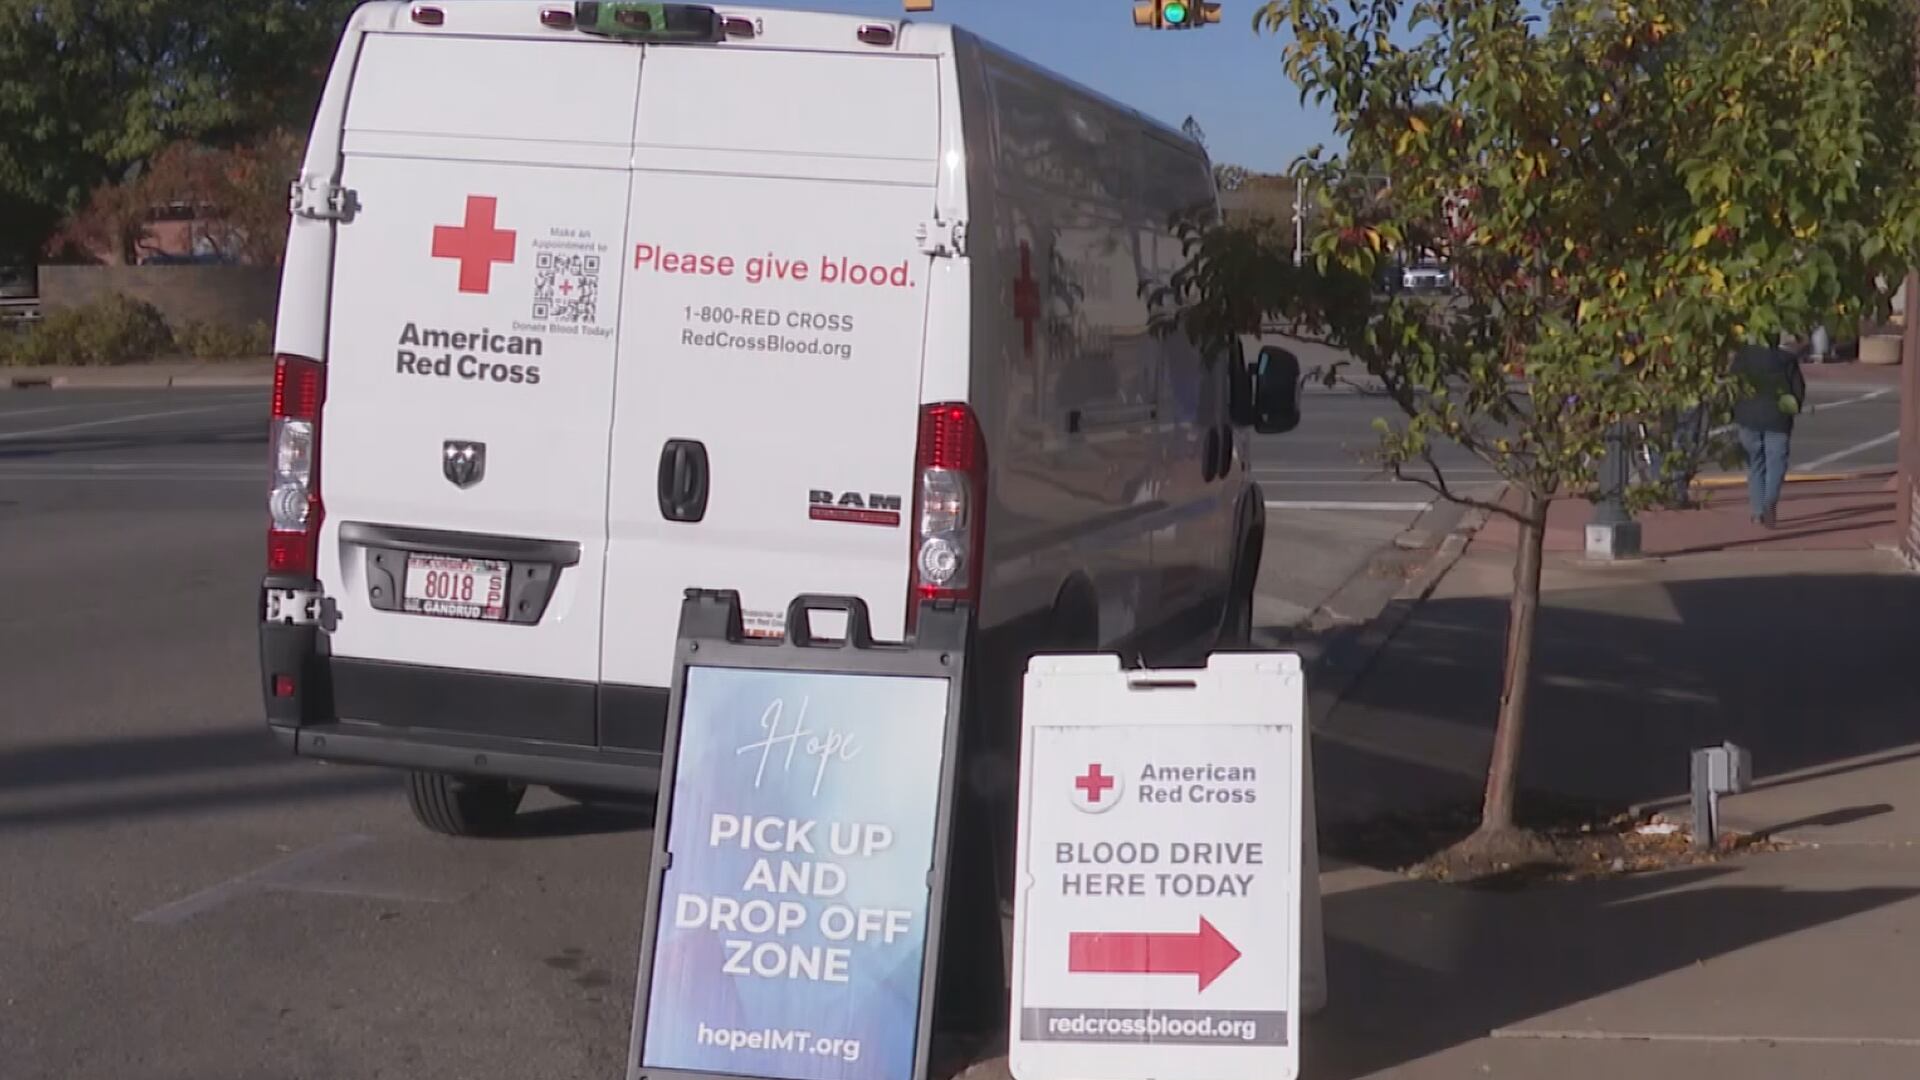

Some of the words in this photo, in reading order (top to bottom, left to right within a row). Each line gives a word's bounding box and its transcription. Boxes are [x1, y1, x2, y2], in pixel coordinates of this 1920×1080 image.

[532, 239, 595, 250] Appointment
[550, 227, 576, 237] Make
[633, 244, 735, 275] Please
[745, 252, 809, 284] give
[820, 255, 916, 287] blood.
[512, 321, 546, 332] Donate
[549, 323, 579, 334] Blood
[582, 325, 614, 338] Today!
[685, 306, 781, 327] 1-800-RED
[786, 312, 854, 332] CROSS
[398, 322, 543, 355] American
[681, 328, 852, 359] RedCrossBlood.org
[396, 350, 452, 376] Red
[456, 354, 541, 384] Cross
[809, 490, 901, 510] RAM
[425, 570, 474, 601] 8018
[423, 600, 480, 618] GANDRUD
[736, 695, 862, 797] Hope
[1140, 763, 1256, 782] American
[1138, 784, 1182, 803] Red
[1188, 784, 1257, 803] Cross
[709, 812, 816, 854] PICK
[829, 821, 893, 857] UP
[1055, 842, 1159, 864] BLOOD
[1170, 842, 1263, 864] DRIVE
[742, 858, 847, 896] AND
[1061, 873, 1146, 896] HERE
[1155, 873, 1254, 897] TODAY
[674, 893, 806, 935] DROP
[819, 904, 913, 943] OFF
[722, 939, 850, 982] ZONE
[1049, 1012, 1257, 1039] redcrossblood.org
[697, 1021, 861, 1061] hopeIMT.org
